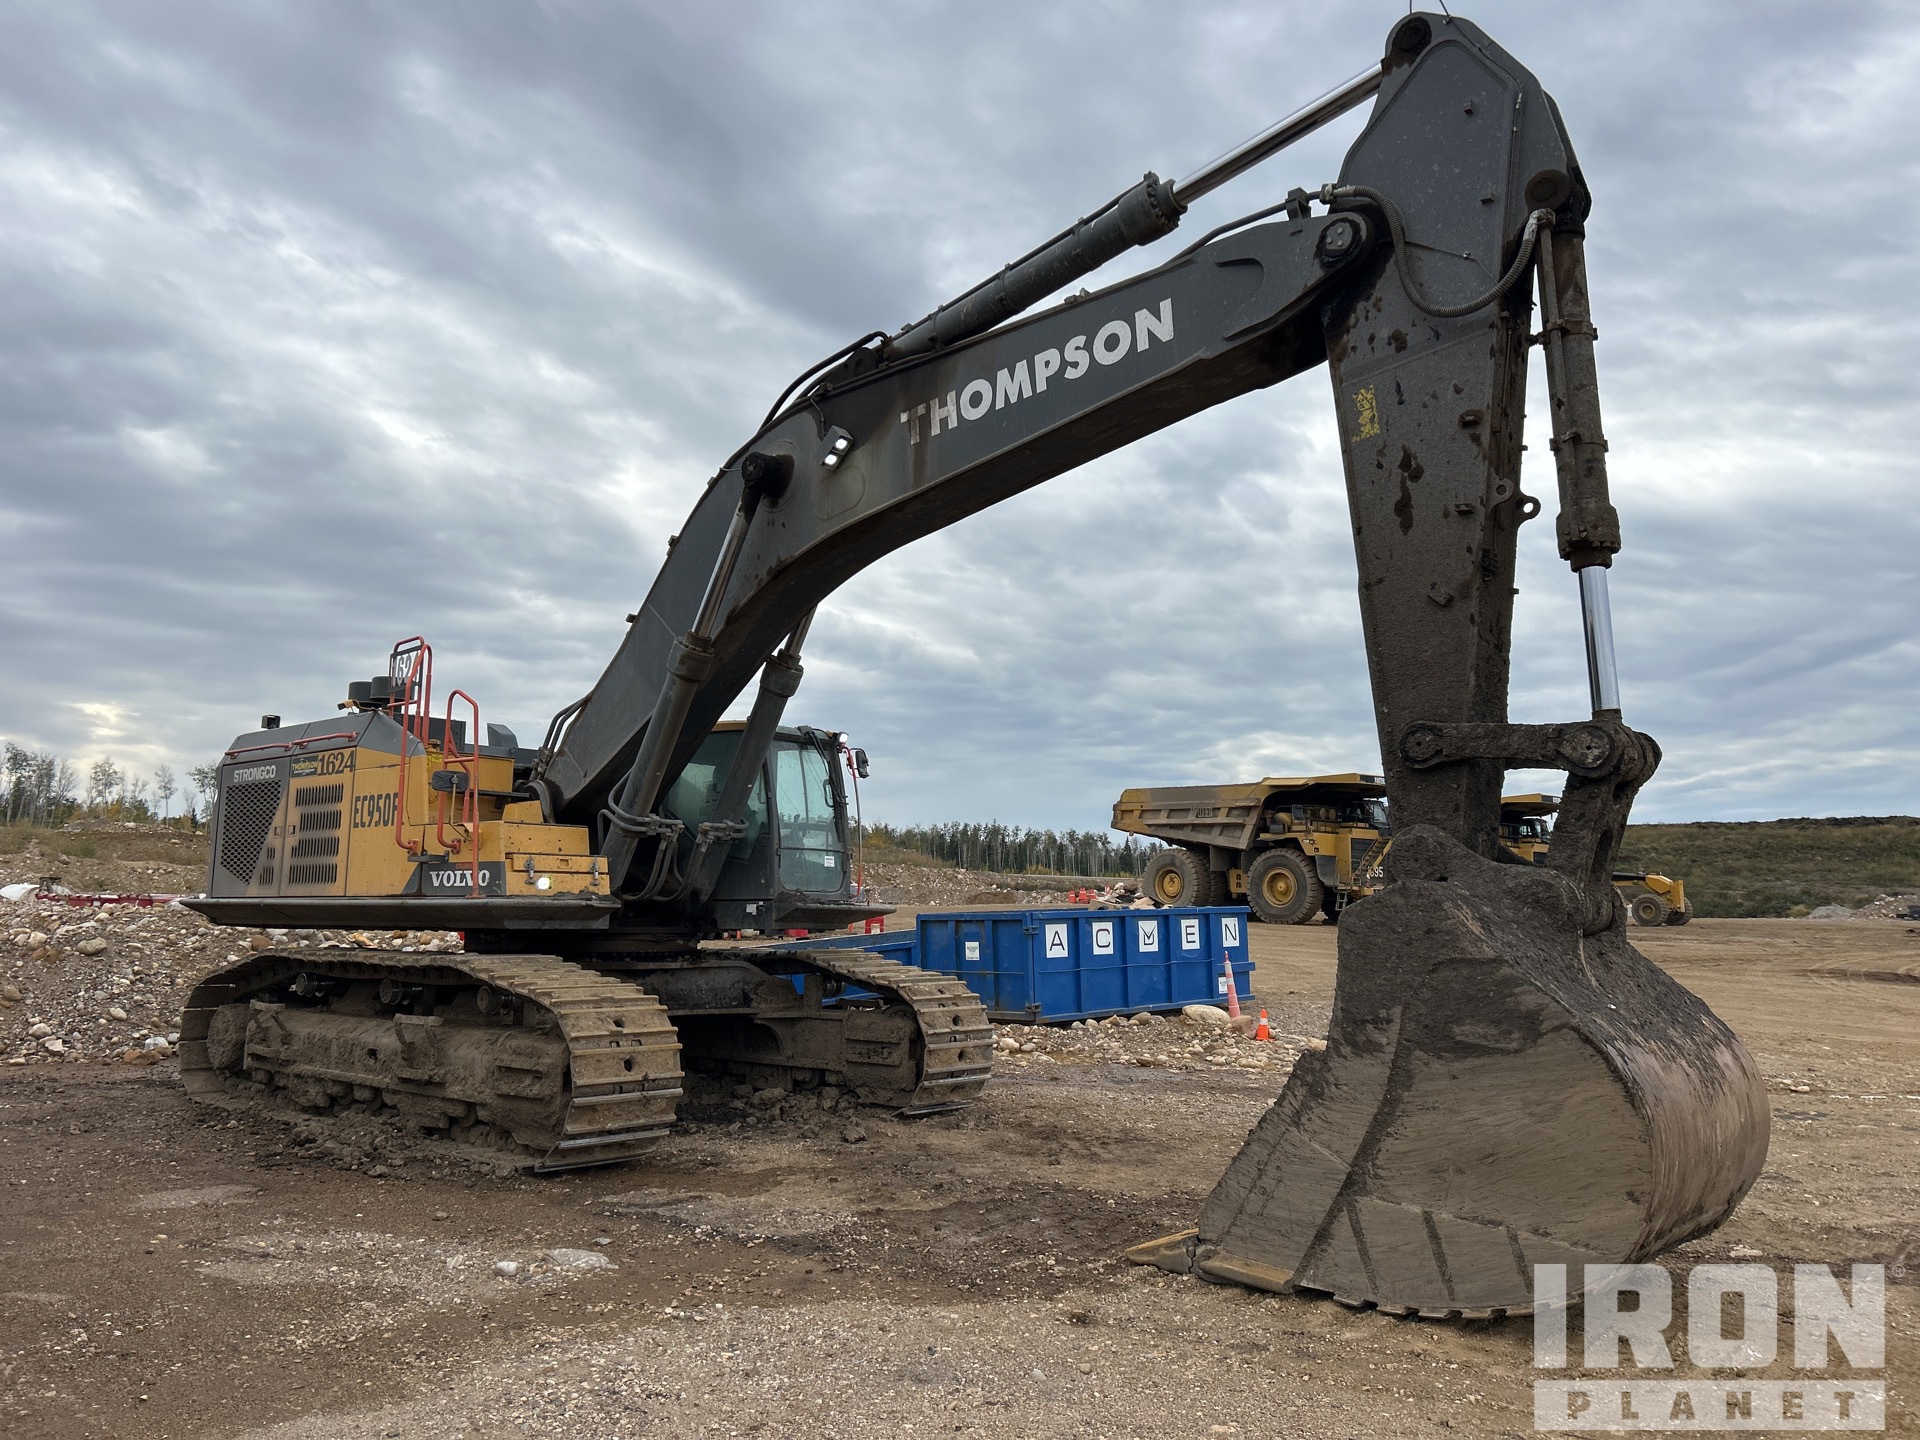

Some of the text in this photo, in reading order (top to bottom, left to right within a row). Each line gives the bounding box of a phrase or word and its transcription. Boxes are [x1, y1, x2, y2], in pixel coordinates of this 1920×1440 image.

[901, 298, 1175, 445] THOMPSON
[233, 765, 276, 783] STRONGCO
[317, 750, 355, 776] 1624
